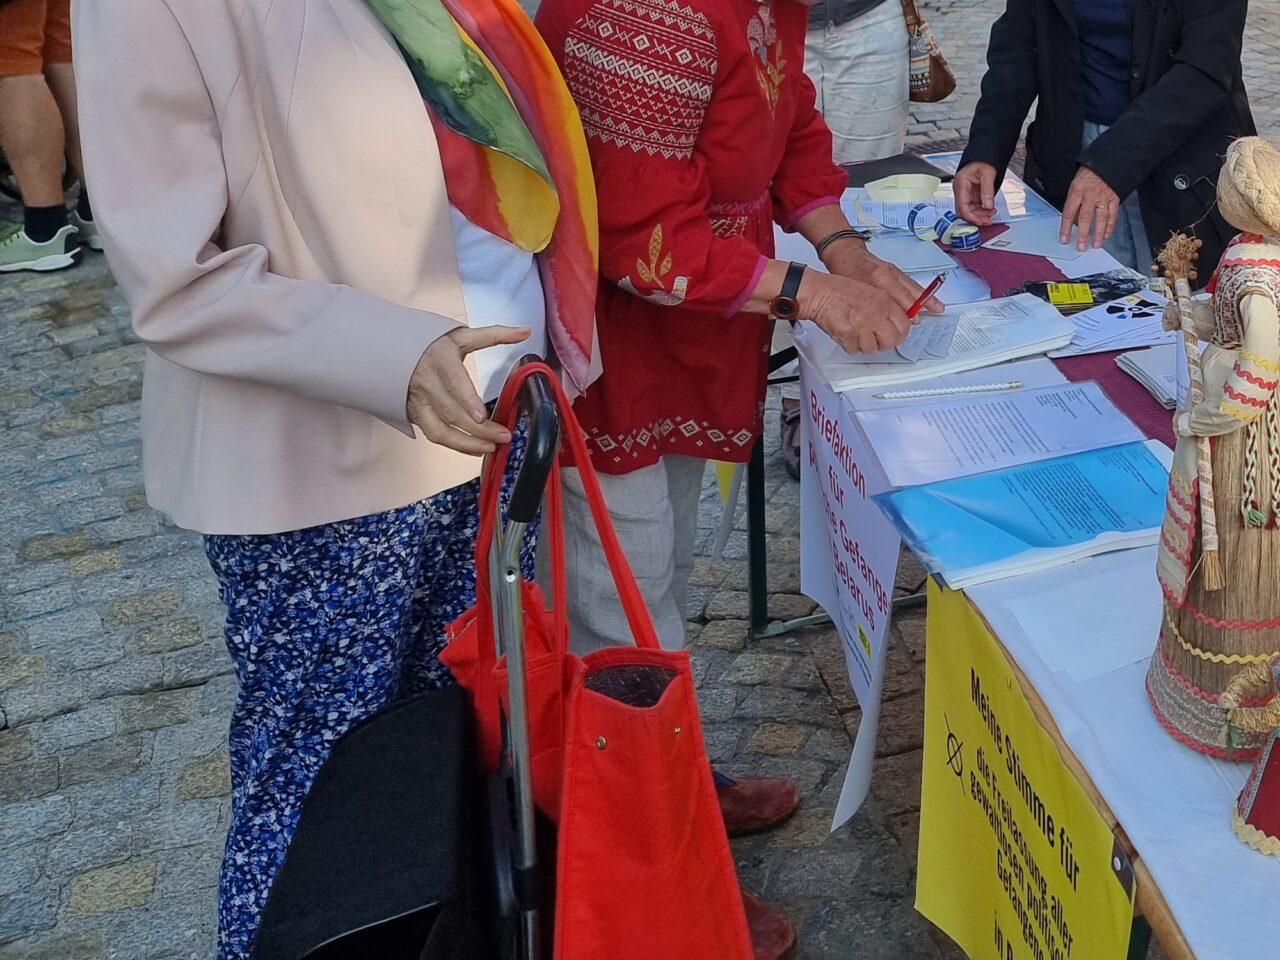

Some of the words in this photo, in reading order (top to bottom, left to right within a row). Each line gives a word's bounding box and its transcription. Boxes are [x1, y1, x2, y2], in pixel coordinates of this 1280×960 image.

[810, 389, 866, 501] Briefaktion
[829, 464, 845, 509] für
[832, 539, 875, 632] Belarus
[840, 519, 890, 617] Gefange
[970, 666, 1003, 756] Meine
[1005, 734, 1055, 849] Stimme
[1059, 826, 1080, 893] für
[970, 770, 1024, 892] gewaltlosen
[976, 745, 991, 787] die
[992, 771, 1048, 911] Freilassung
[1051, 894, 1074, 959] aller
